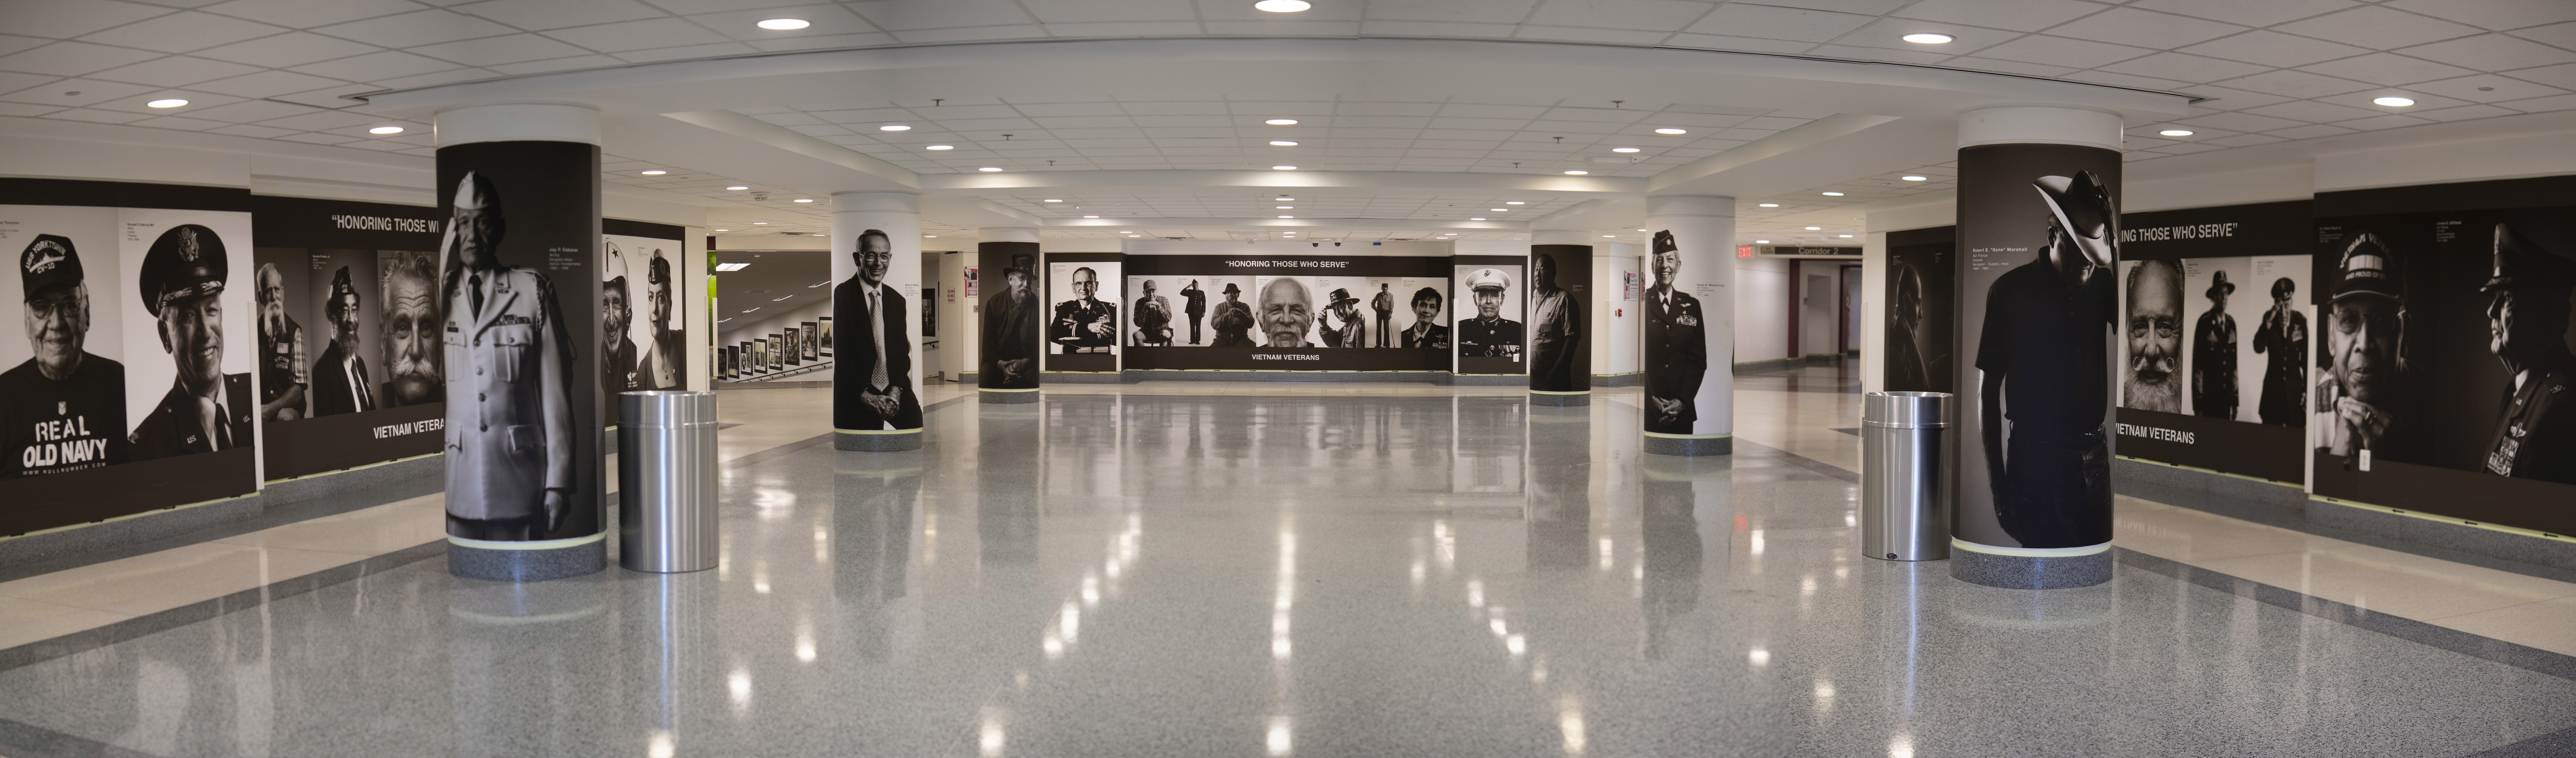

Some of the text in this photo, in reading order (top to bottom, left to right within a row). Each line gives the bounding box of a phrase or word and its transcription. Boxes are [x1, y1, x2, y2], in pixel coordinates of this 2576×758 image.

[332, 215, 391, 231] “HONORING
[394, 218, 426, 232] THOSE
[2120, 223, 2237, 242] ING THOSE WHO SERVE”
[25, 240, 66, 269] USS YORKTOWN
[1738, 247, 1752, 258] EXIT
[2339, 233, 2366, 269] VIETNAM
[37, 262, 55, 274] CV-10
[2345, 272, 2355, 281] AND
[35, 415, 90, 442] REAL
[374, 423, 411, 439] VIETNAM
[2149, 427, 2194, 444] VETERANS
[23, 439, 107, 468] OLD NAVY
